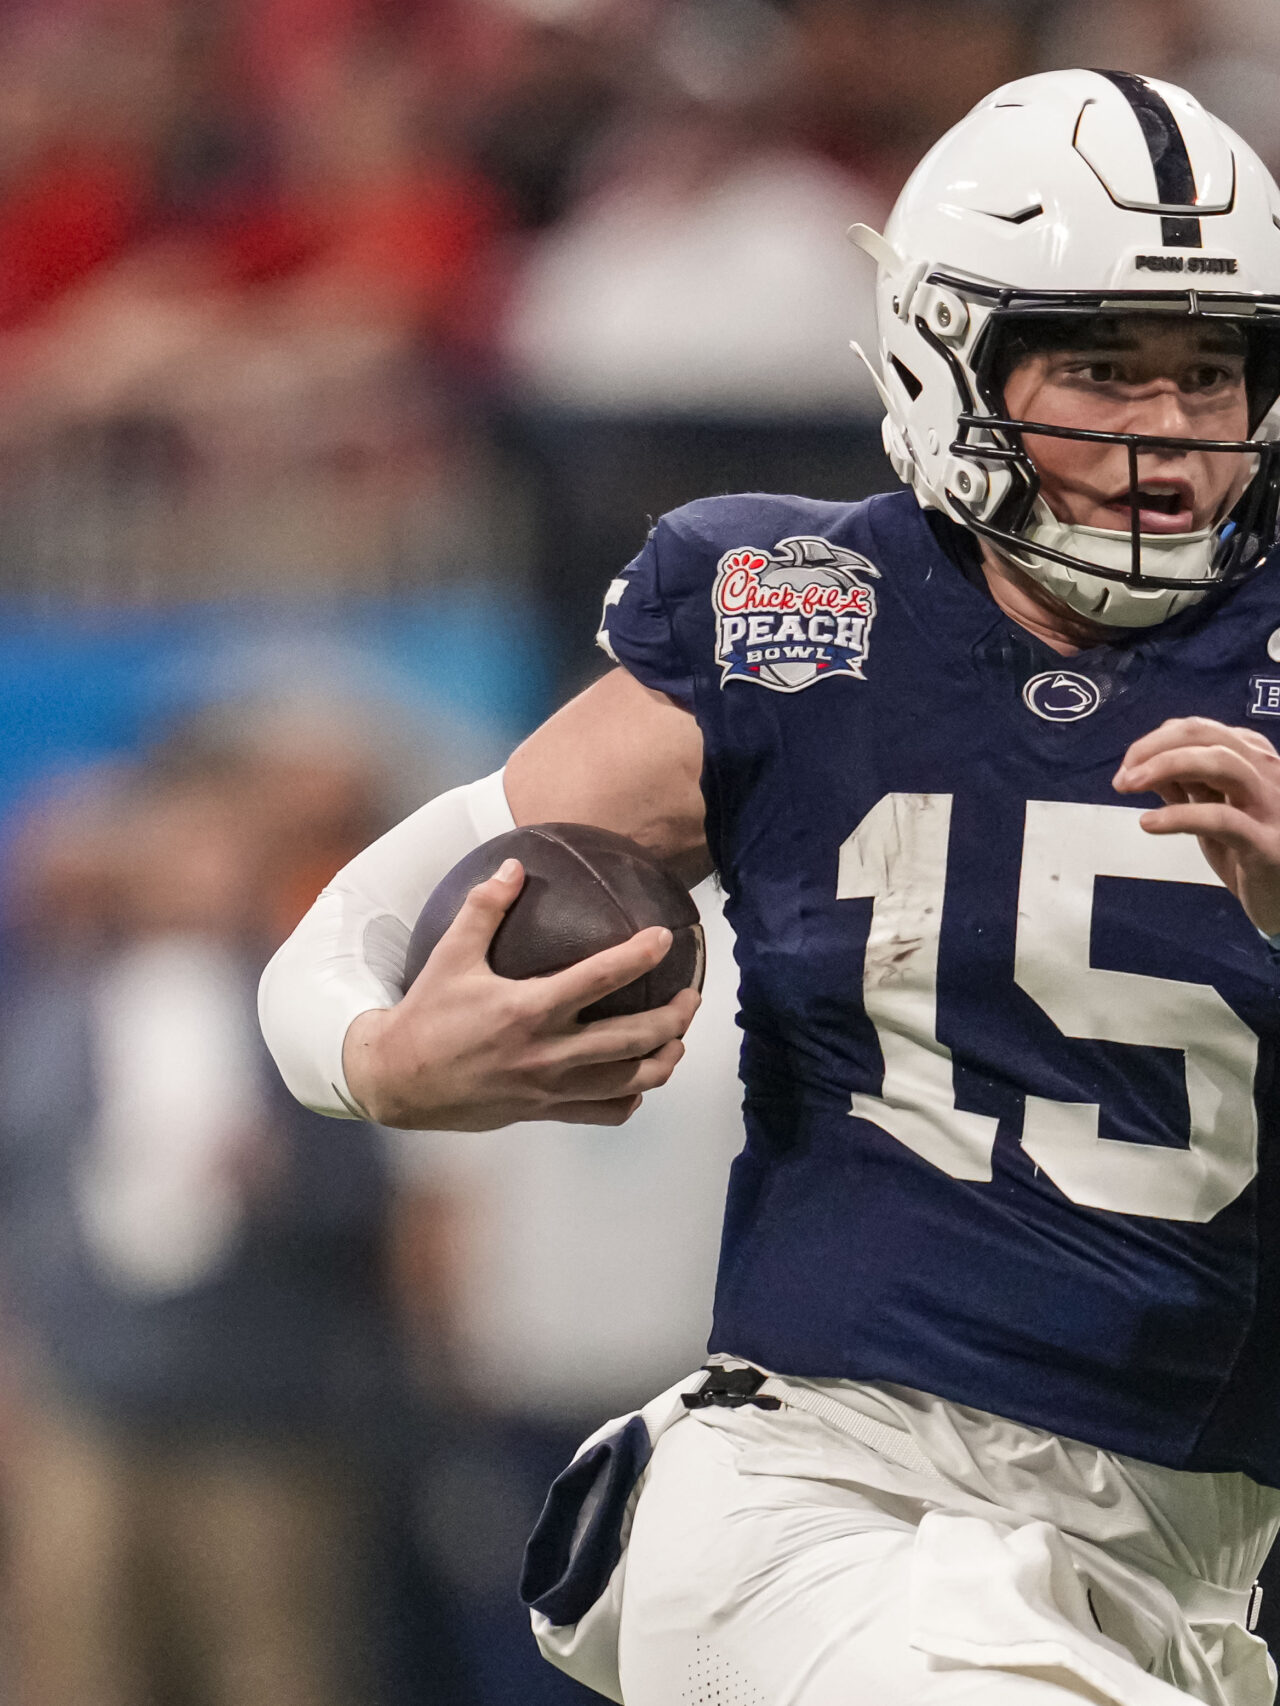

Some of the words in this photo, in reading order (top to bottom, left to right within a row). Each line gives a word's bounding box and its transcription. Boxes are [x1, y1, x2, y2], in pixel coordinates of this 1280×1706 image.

[1135, 255, 1183, 273] PENN
[1187, 257, 1238, 274] STATE
[720, 566, 868, 615] Chick-fil-A
[720, 615, 867, 656] PEACH
[746, 646, 833, 663] BOWL
[836, 792, 1259, 1223] 15
